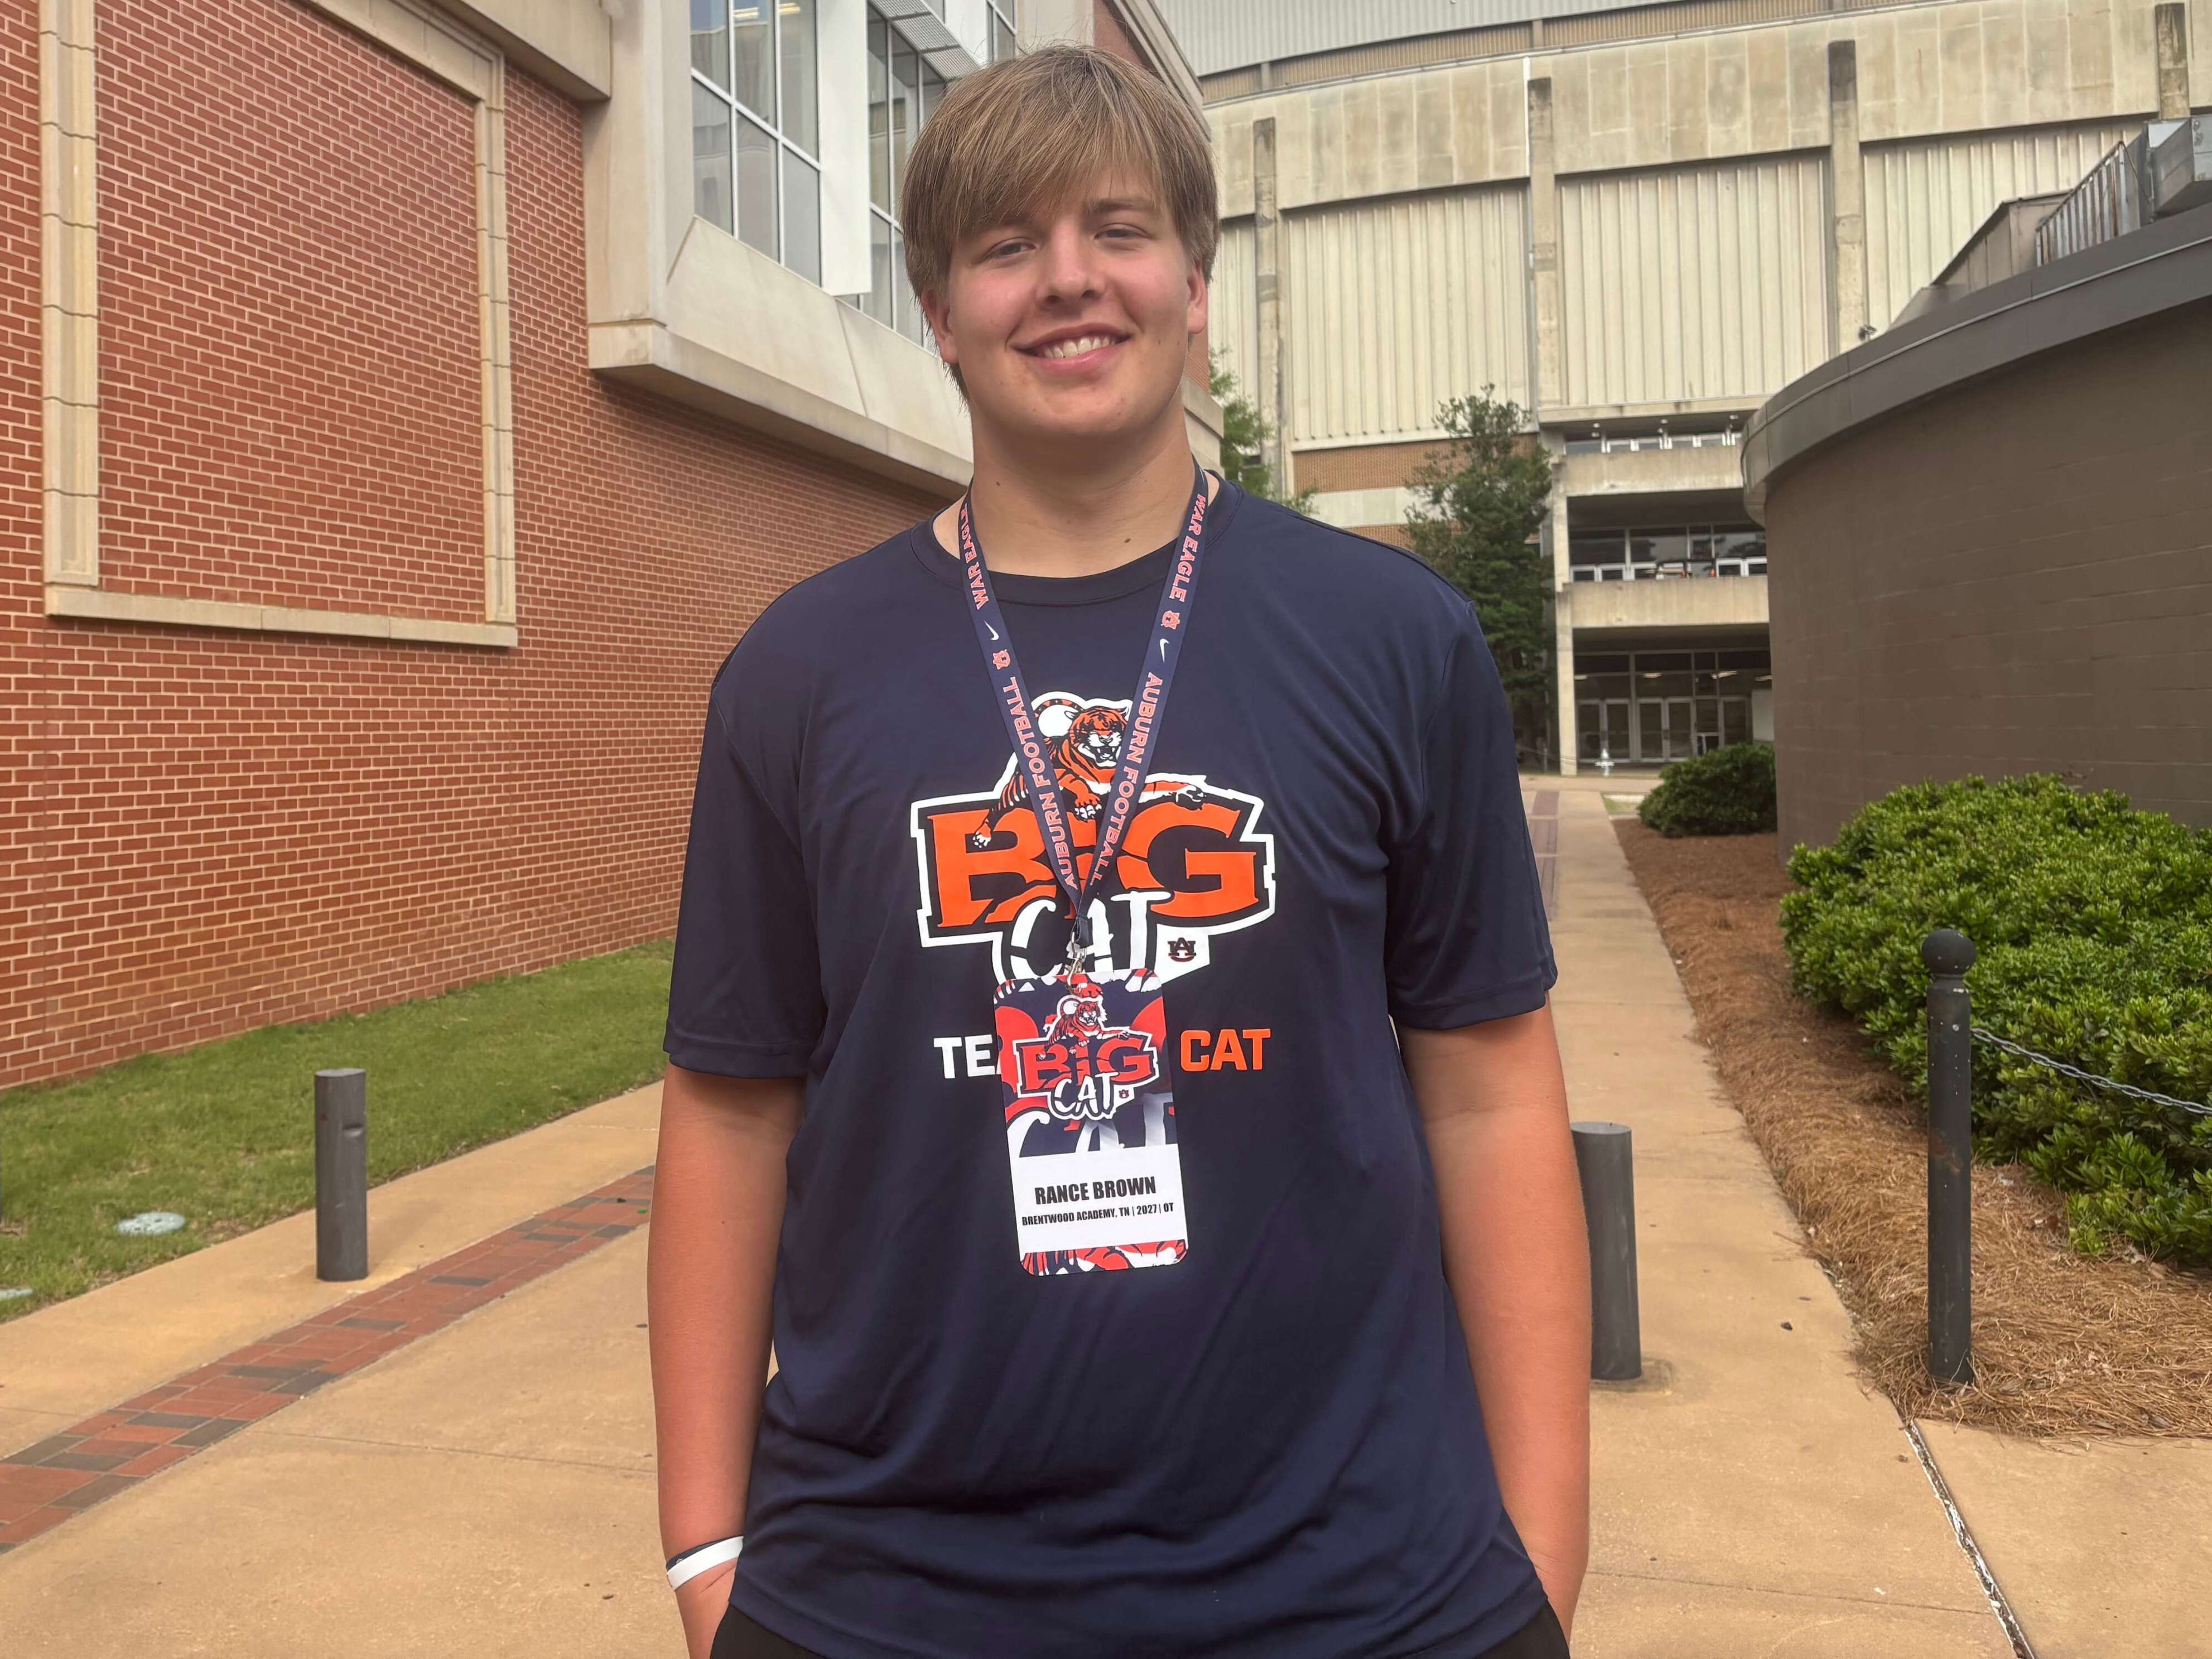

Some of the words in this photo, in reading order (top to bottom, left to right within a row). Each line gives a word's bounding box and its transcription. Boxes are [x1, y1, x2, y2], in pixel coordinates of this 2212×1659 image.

[961, 503, 977, 563] EAGLE
[1188, 493, 1206, 536] WAR
[968, 561, 989, 610] WAR
[1169, 535, 1198, 602] EAGLE
[1003, 676, 1051, 788] FOOTBALL
[1126, 672, 1163, 764] AUBURN
[1038, 792, 1078, 890] AUBURN
[1090, 765, 1139, 886] FOOTBALL
[933, 1034, 1001, 1079] TE
[1180, 1028, 1271, 1072] CAT
[1054, 1072, 1120, 1114] CAT
[1021, 1212, 1075, 1226] BRENTWOOD
[1077, 1208, 1117, 1221] ACADEMY,
[1119, 1206, 1130, 1217] TN
[1136, 1203, 1158, 1216] 2027
[1163, 1202, 1174, 1213] OT
[1034, 1182, 1090, 1205] RANCE
[1092, 1176, 1156, 1199] BROWN
